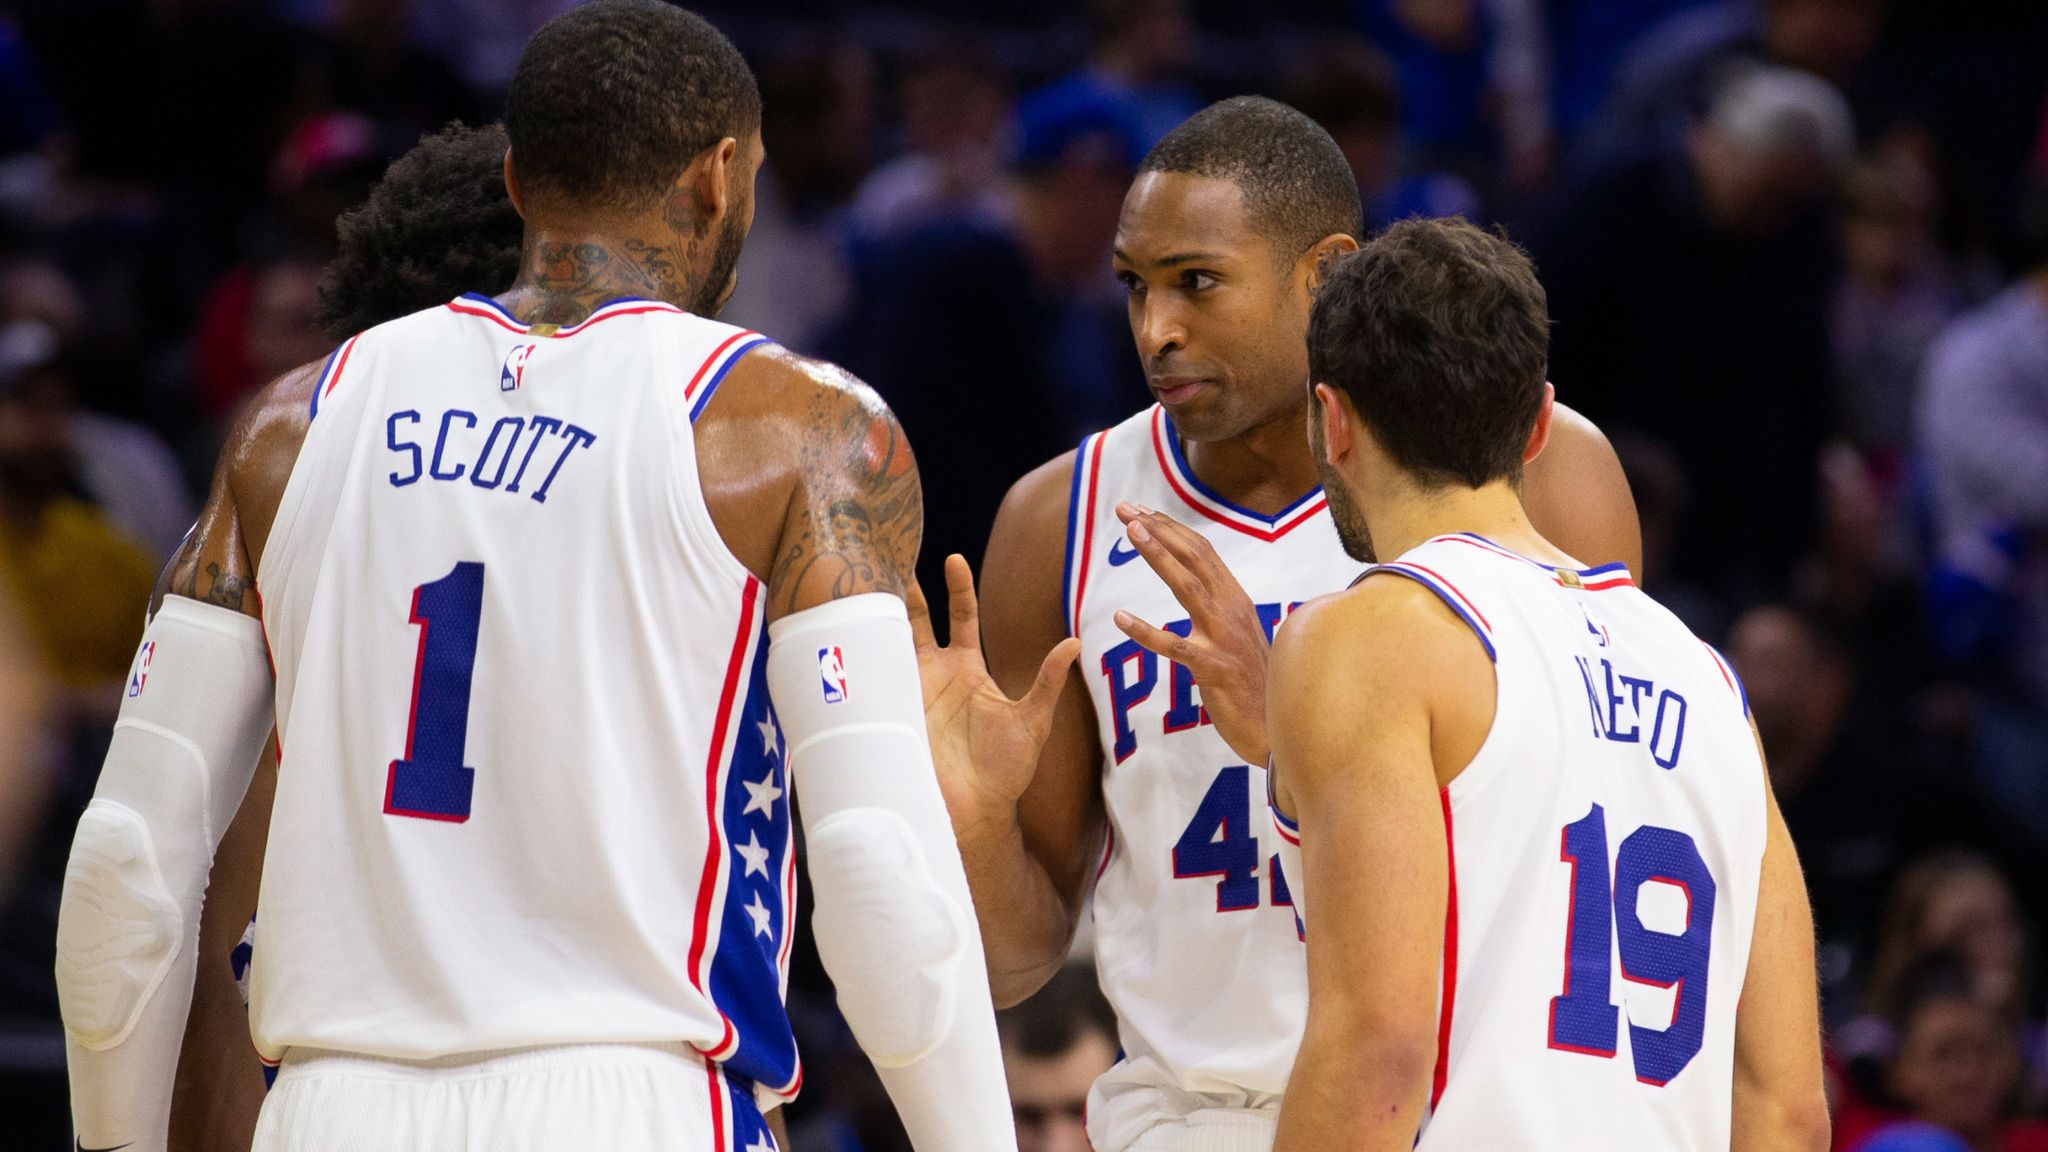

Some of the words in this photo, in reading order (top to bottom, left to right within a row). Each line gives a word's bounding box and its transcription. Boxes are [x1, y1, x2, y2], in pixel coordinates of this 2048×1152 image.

[387, 408, 597, 503] SCOTT
[383, 561, 485, 824] 1
[1574, 655, 1687, 770] NETO
[1173, 765, 1294, 913] 4
[1547, 801, 1716, 1087] 19
